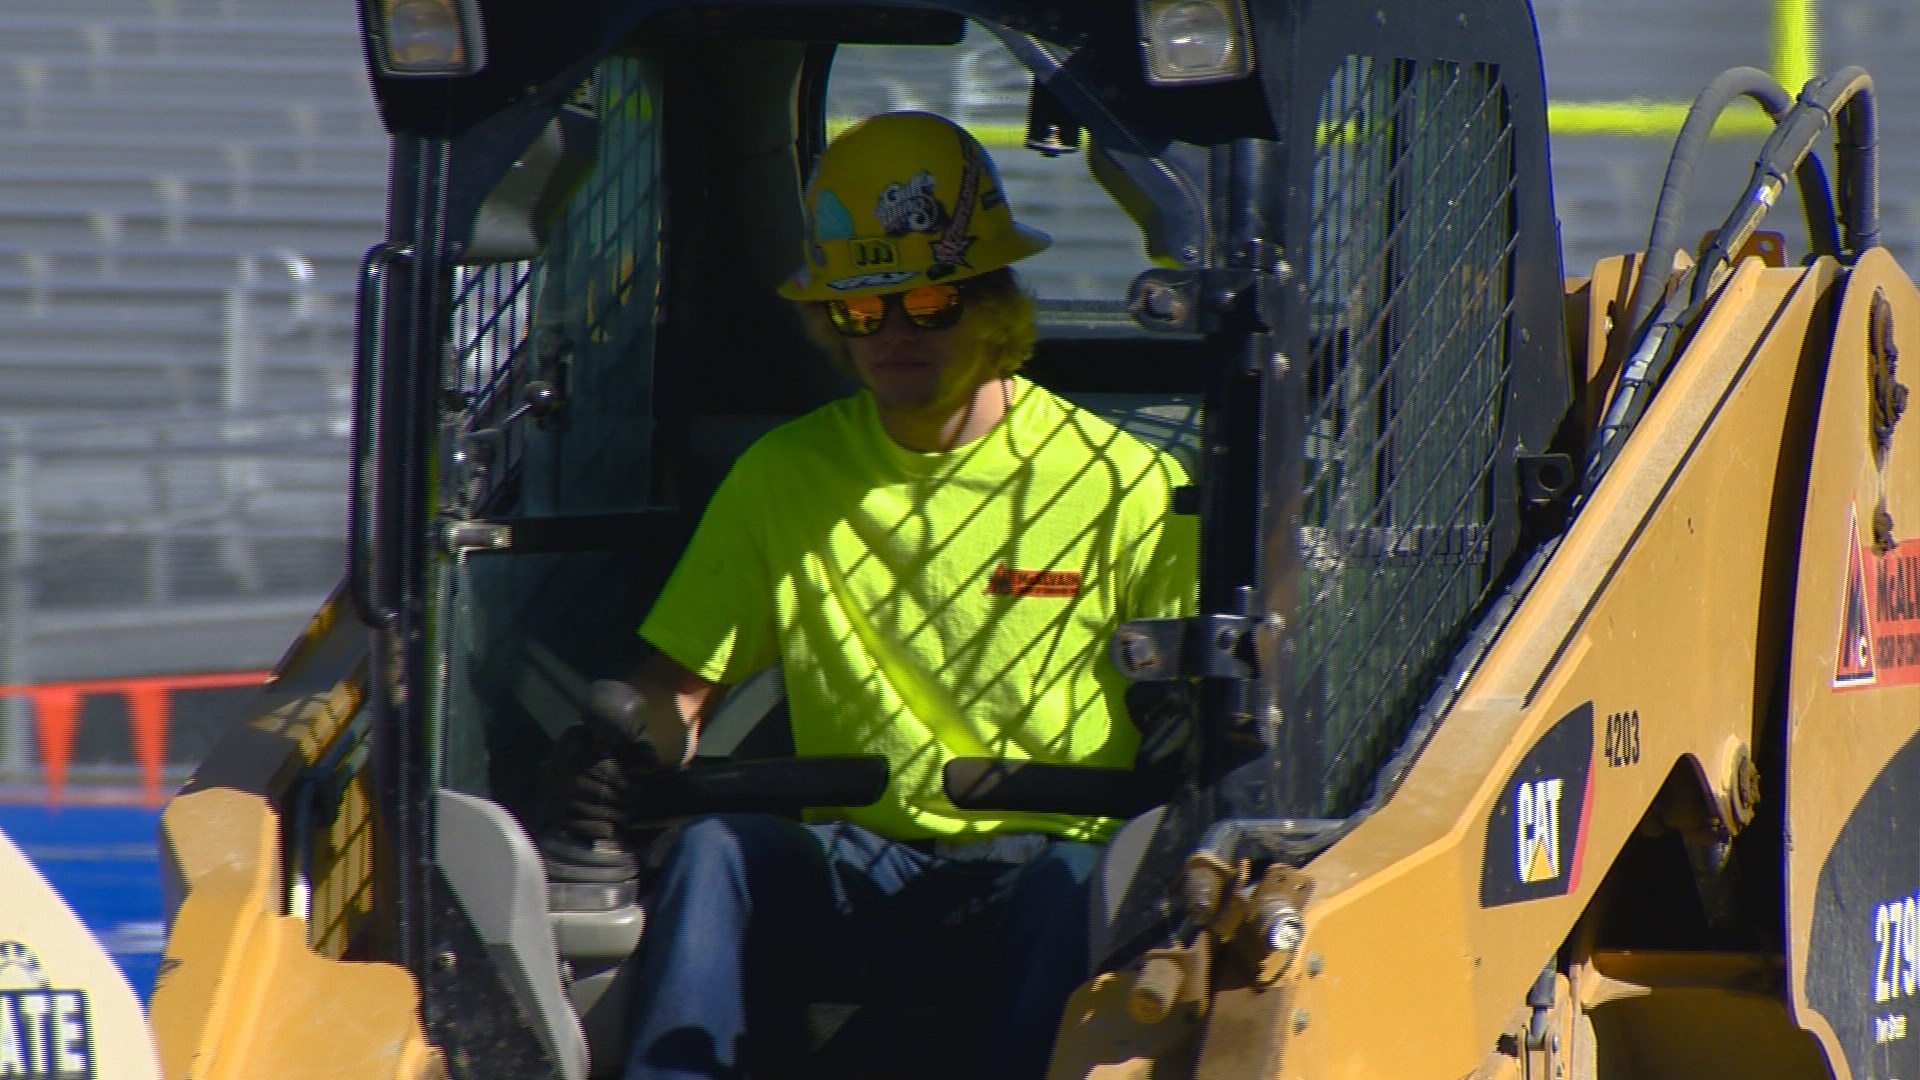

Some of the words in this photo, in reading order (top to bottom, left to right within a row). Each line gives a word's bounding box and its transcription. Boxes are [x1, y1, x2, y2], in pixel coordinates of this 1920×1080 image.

[1604, 710, 1640, 768] 4203
[1518, 778, 1563, 883] CAT
[1874, 896, 1920, 1003] 279
[0, 993, 86, 1073] ATE
